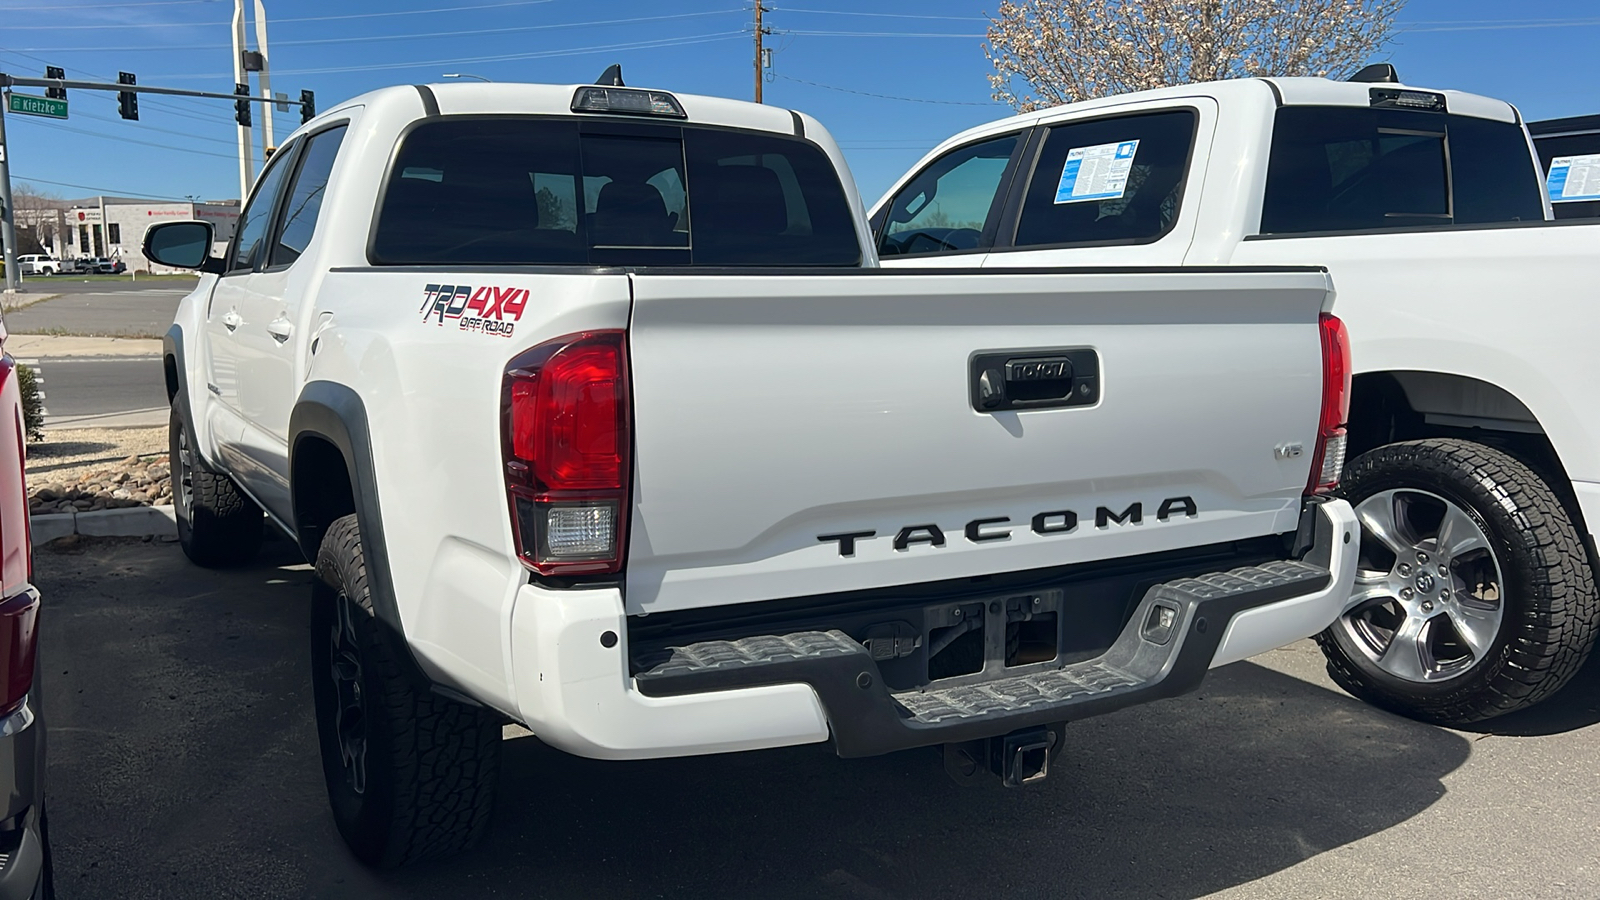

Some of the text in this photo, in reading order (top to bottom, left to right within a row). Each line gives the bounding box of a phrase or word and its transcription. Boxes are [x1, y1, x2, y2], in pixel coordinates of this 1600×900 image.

[22, 99, 55, 113] Kietzke
[419, 284, 530, 326] TRD 4X4
[459, 316, 514, 337] OFF ROAD
[1013, 362, 1068, 379] TOYOTA
[1273, 443, 1304, 460] V6
[817, 495, 1198, 558] TACOMA
